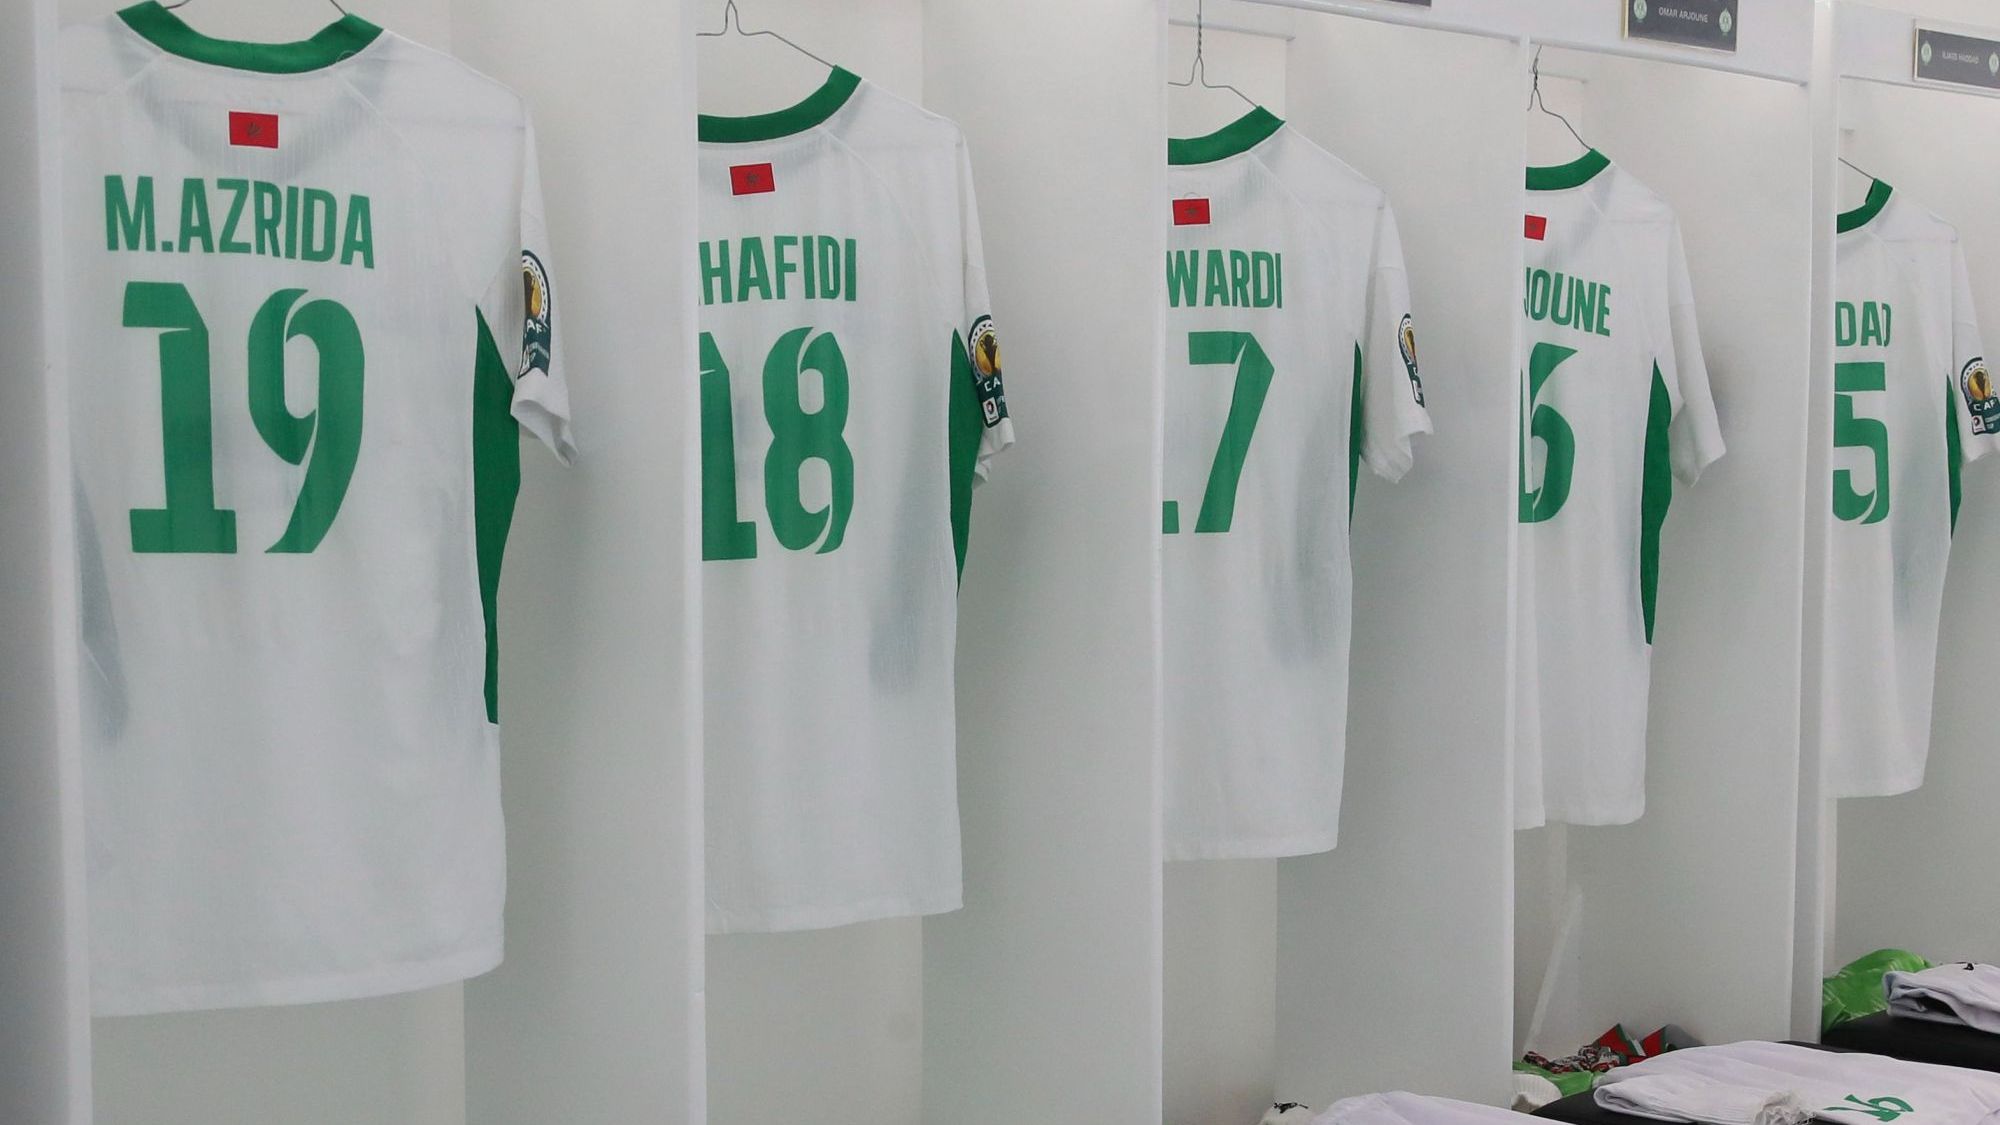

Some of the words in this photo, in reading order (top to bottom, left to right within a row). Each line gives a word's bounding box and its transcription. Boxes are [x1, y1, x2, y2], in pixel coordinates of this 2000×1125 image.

[1658, 6, 1678, 18] OMAR
[1679, 10, 1709, 23] ARJOUNE
[104, 175, 375, 269] M.AZRIDA
[698, 235, 857, 305] HAFIDI
[1166, 249, 1282, 309] WARDI
[122, 281, 365, 554] 19
[698, 326, 854, 562] 18
[1162, 331, 1275, 534] 7
[1832, 362, 1890, 525] 5
